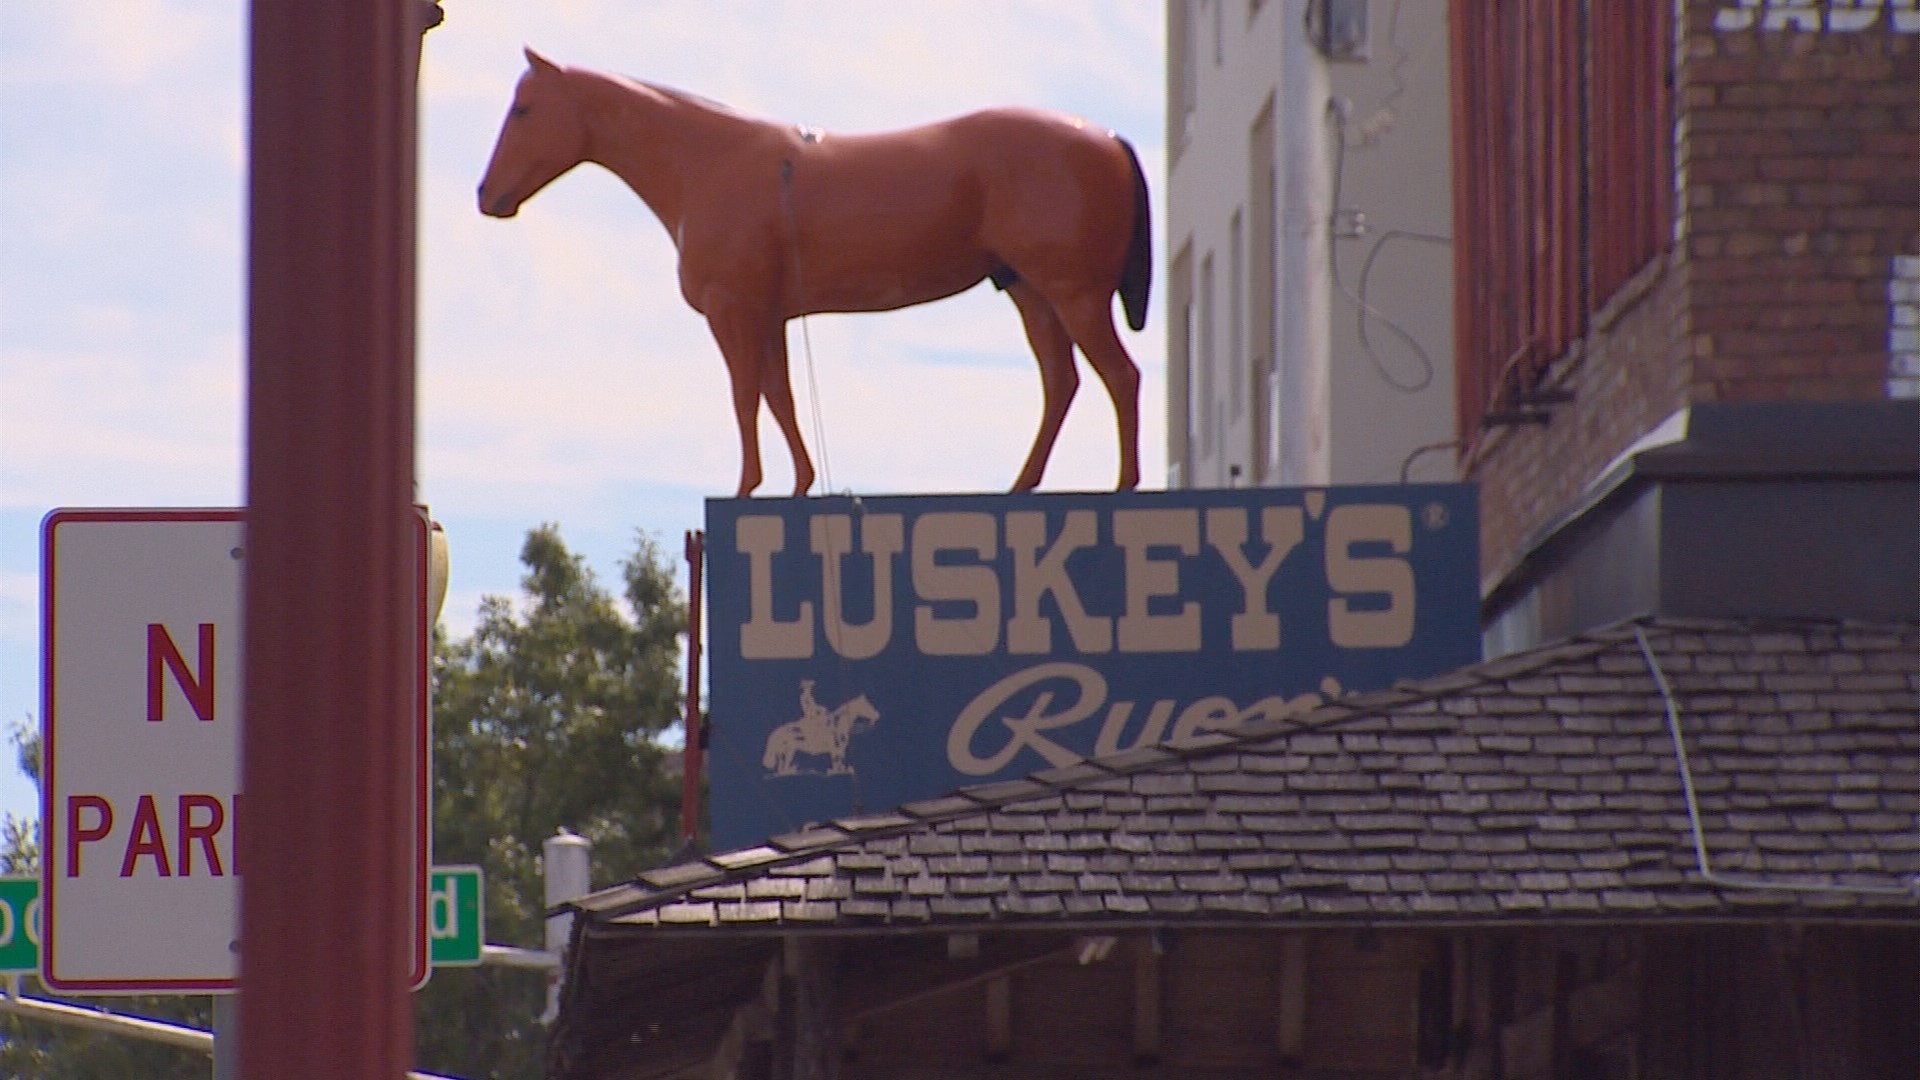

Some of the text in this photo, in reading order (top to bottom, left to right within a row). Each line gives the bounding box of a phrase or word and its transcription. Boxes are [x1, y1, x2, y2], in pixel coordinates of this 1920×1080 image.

[736, 489, 1416, 660] LUSKEY'S
[147, 623, 215, 722] N
[67, 794, 243, 878] PAR
